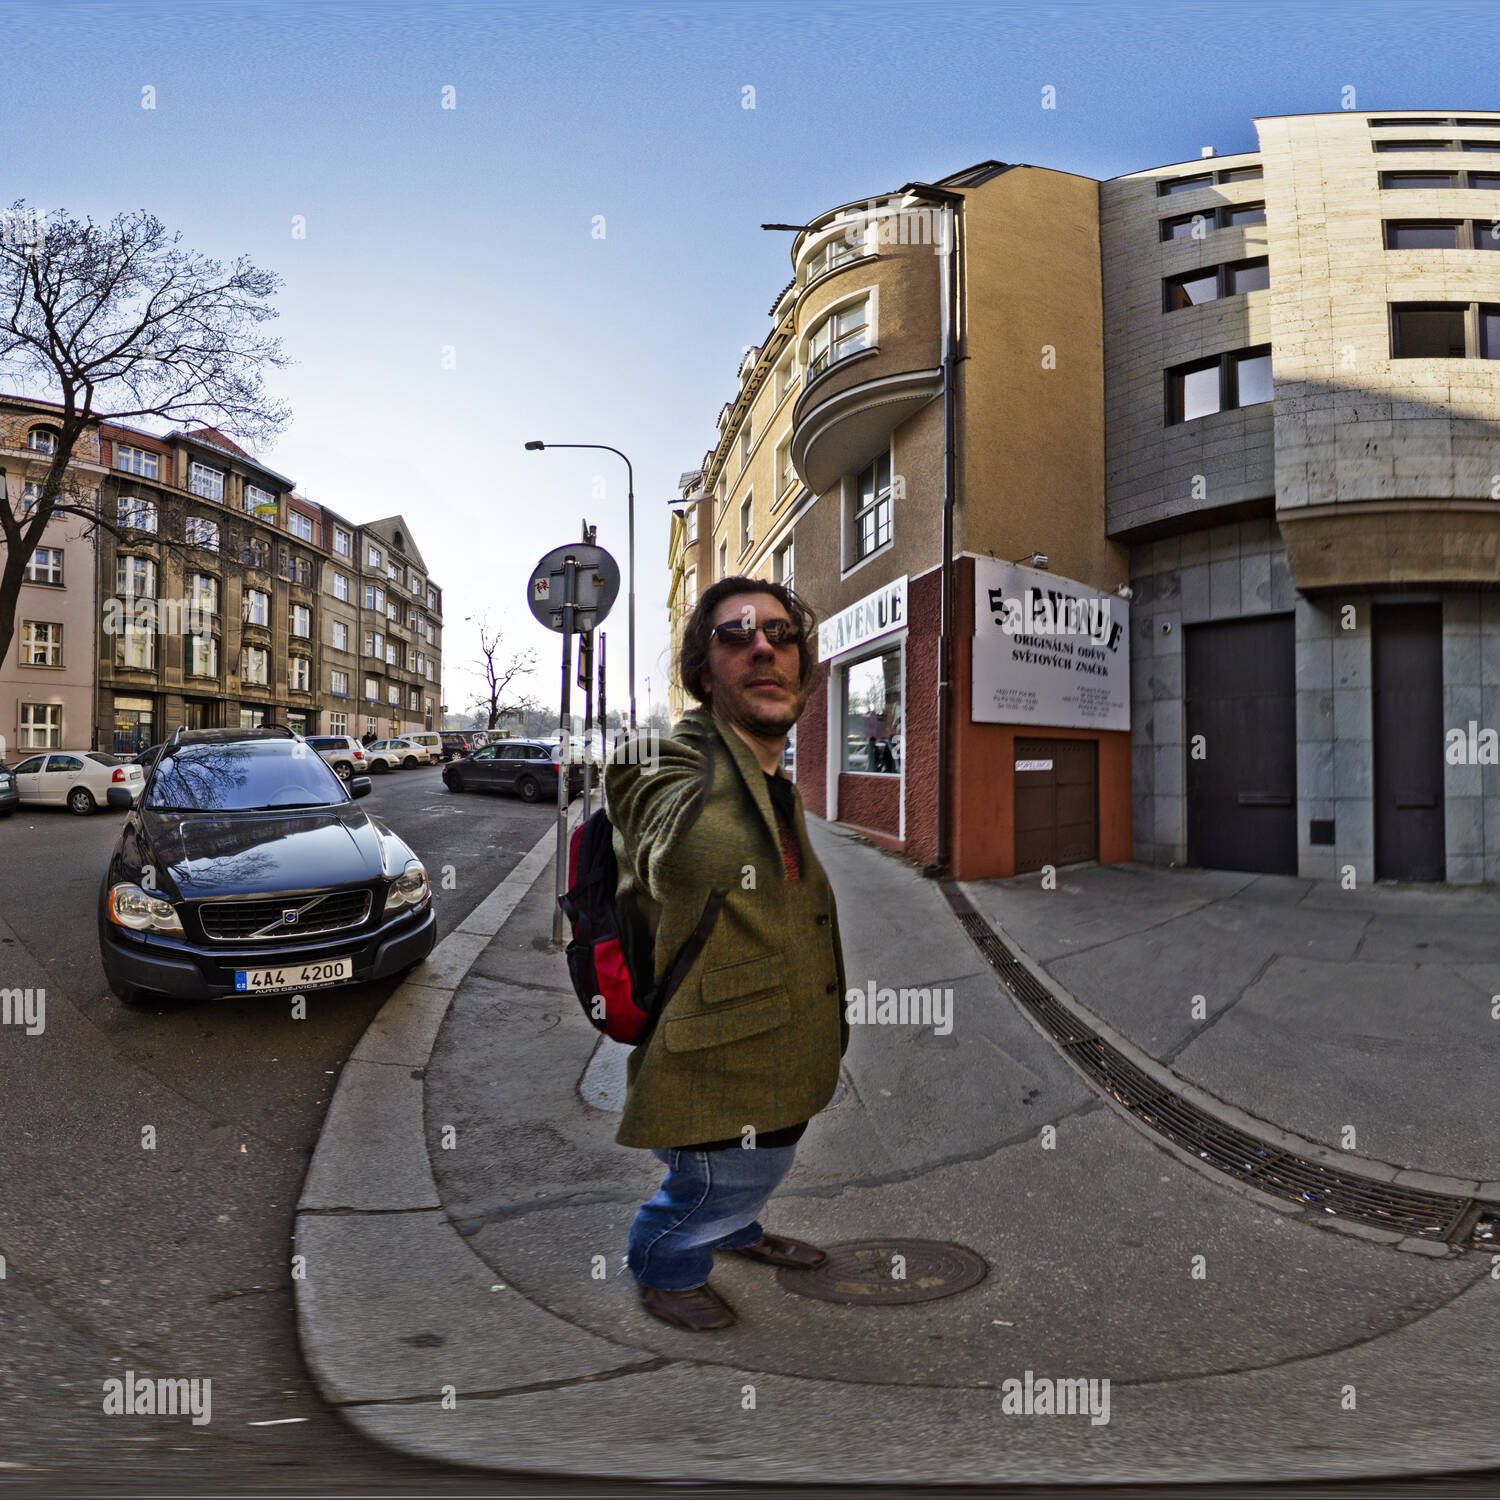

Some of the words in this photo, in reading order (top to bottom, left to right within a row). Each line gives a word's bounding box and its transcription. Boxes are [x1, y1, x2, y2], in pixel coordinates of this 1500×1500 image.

[836, 584, 902, 649] AVENUE
[1031, 586, 1123, 654] AVENUE
[1014, 634, 1074, 656] ORIGINÁLNÍ
[1075, 658, 1109, 677] ZNAČEK
[251, 971, 286, 988] 4A4
[300, 962, 345, 982] 4200
